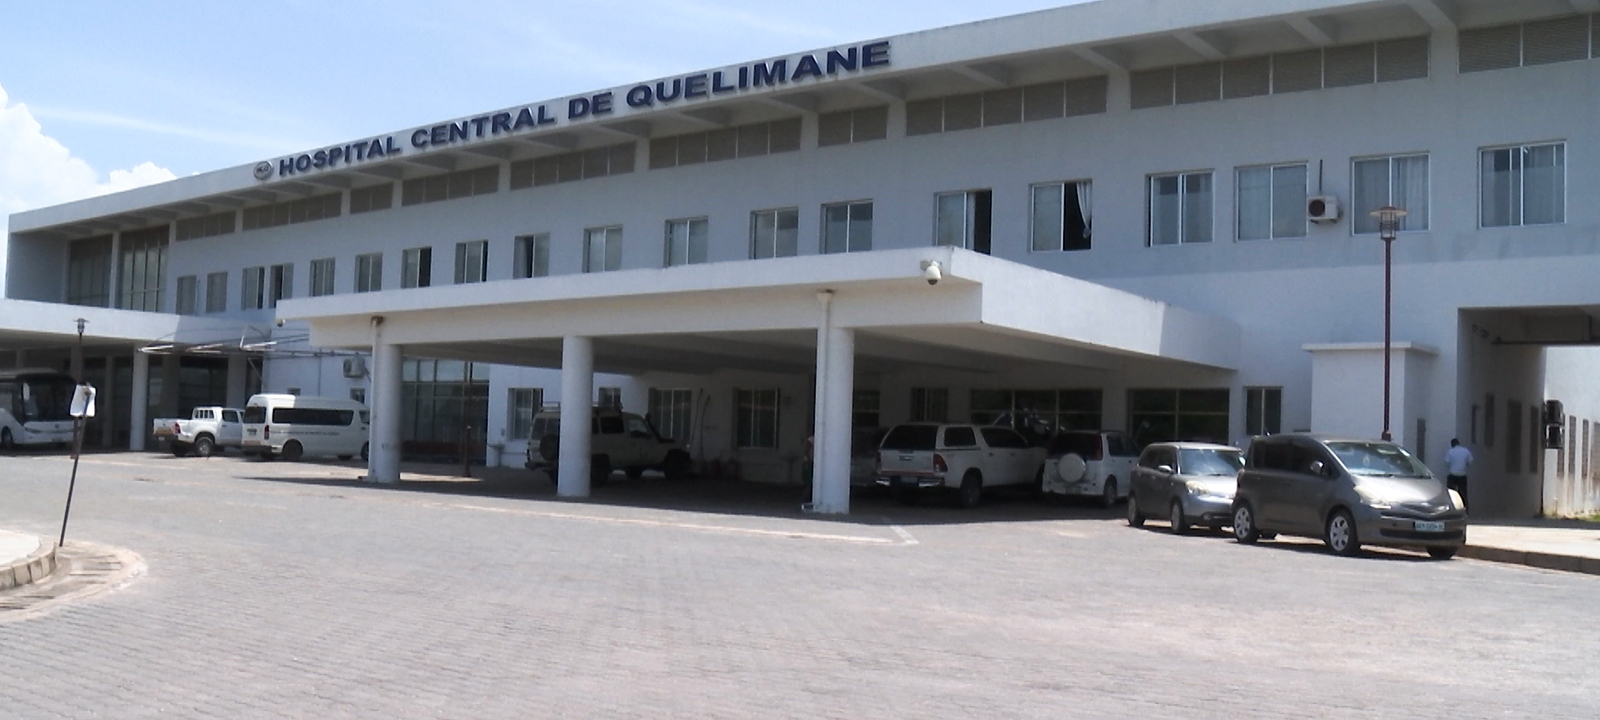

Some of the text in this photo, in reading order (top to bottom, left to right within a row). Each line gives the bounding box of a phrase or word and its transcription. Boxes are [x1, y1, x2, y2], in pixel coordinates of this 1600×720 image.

[279, 40, 891, 176] HOSPITAL CENTRAL DE QUELIMANE
